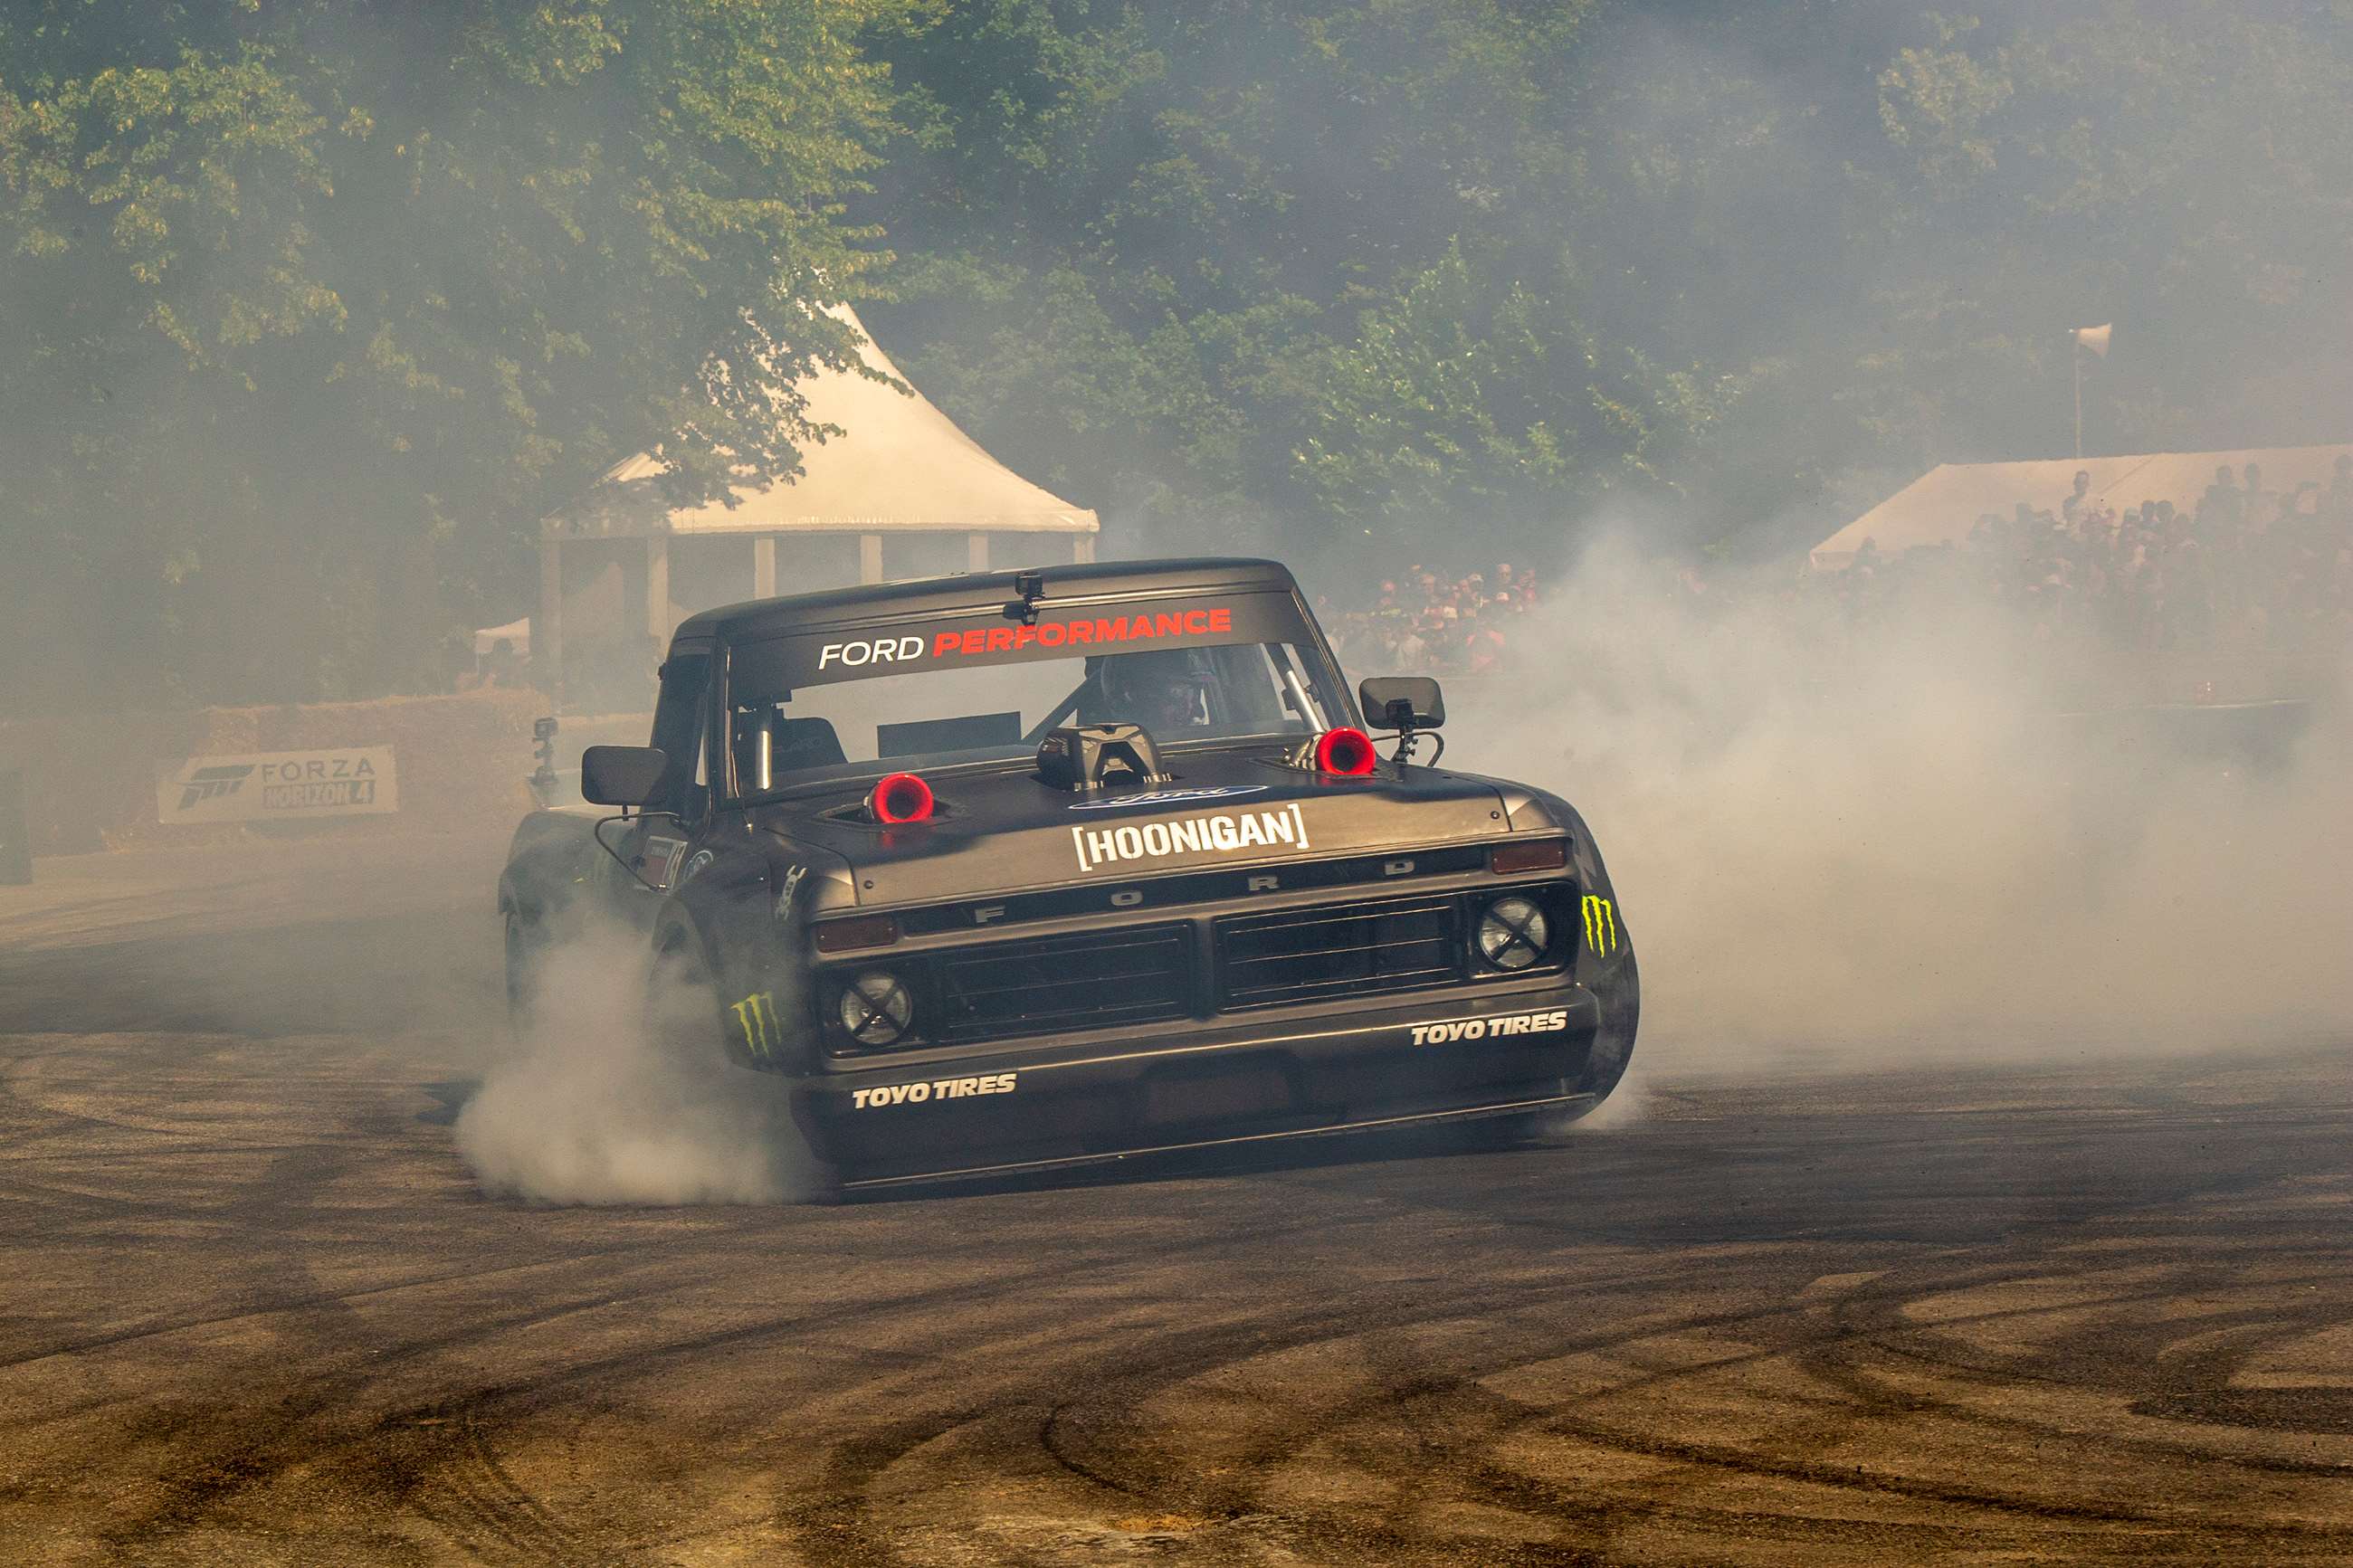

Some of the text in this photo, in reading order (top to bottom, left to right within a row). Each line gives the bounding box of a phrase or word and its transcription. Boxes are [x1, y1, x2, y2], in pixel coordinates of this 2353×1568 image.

[819, 609, 1232, 670] FORD PERFORMANCE
[262, 758, 376, 782] FORZA
[1110, 787, 1230, 805] Ford
[1411, 1012, 1567, 1046] TOYO TIRES
[853, 1073, 1017, 1109] TOYO TIRES
